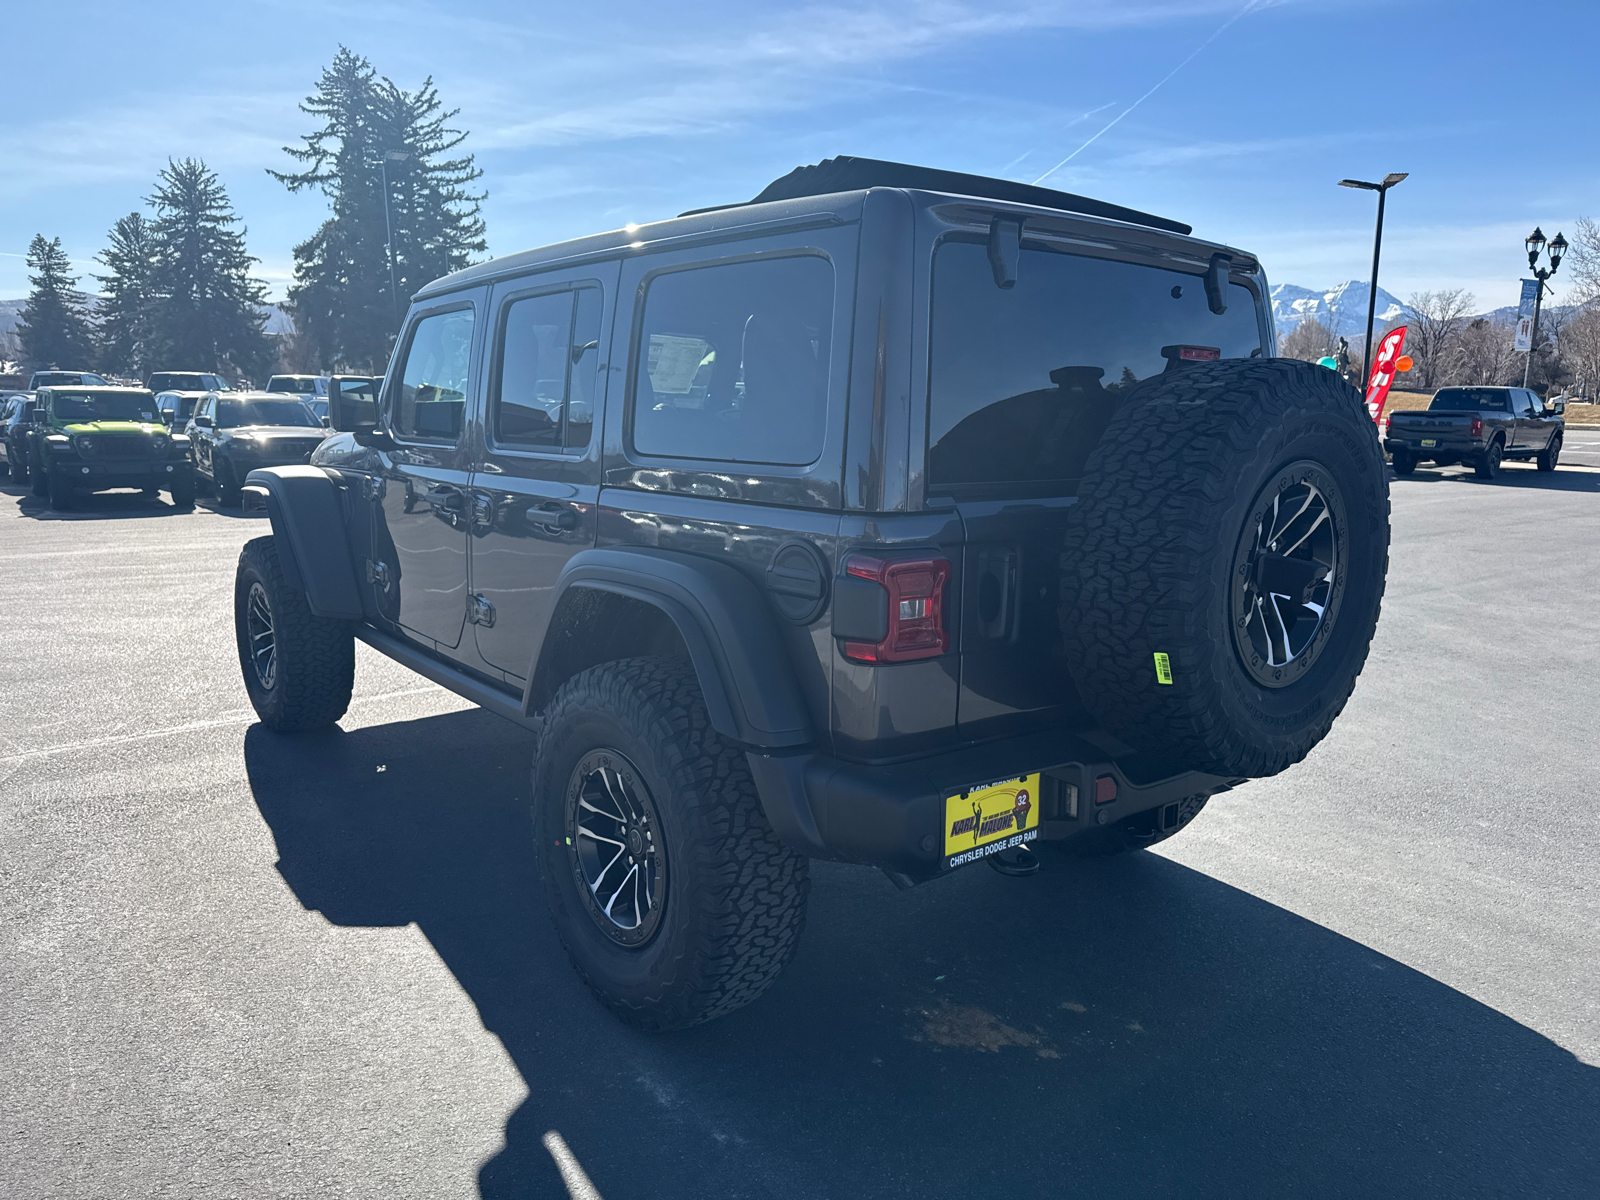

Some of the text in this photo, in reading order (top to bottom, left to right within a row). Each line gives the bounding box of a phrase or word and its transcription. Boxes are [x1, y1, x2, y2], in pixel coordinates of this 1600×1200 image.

[1017, 794, 1027, 806] 32
[950, 816, 976, 838] KARL
[979, 813, 1014, 838] MALONE
[949, 829, 1038, 868] CHRYSLER DODGE JEEP RAM
